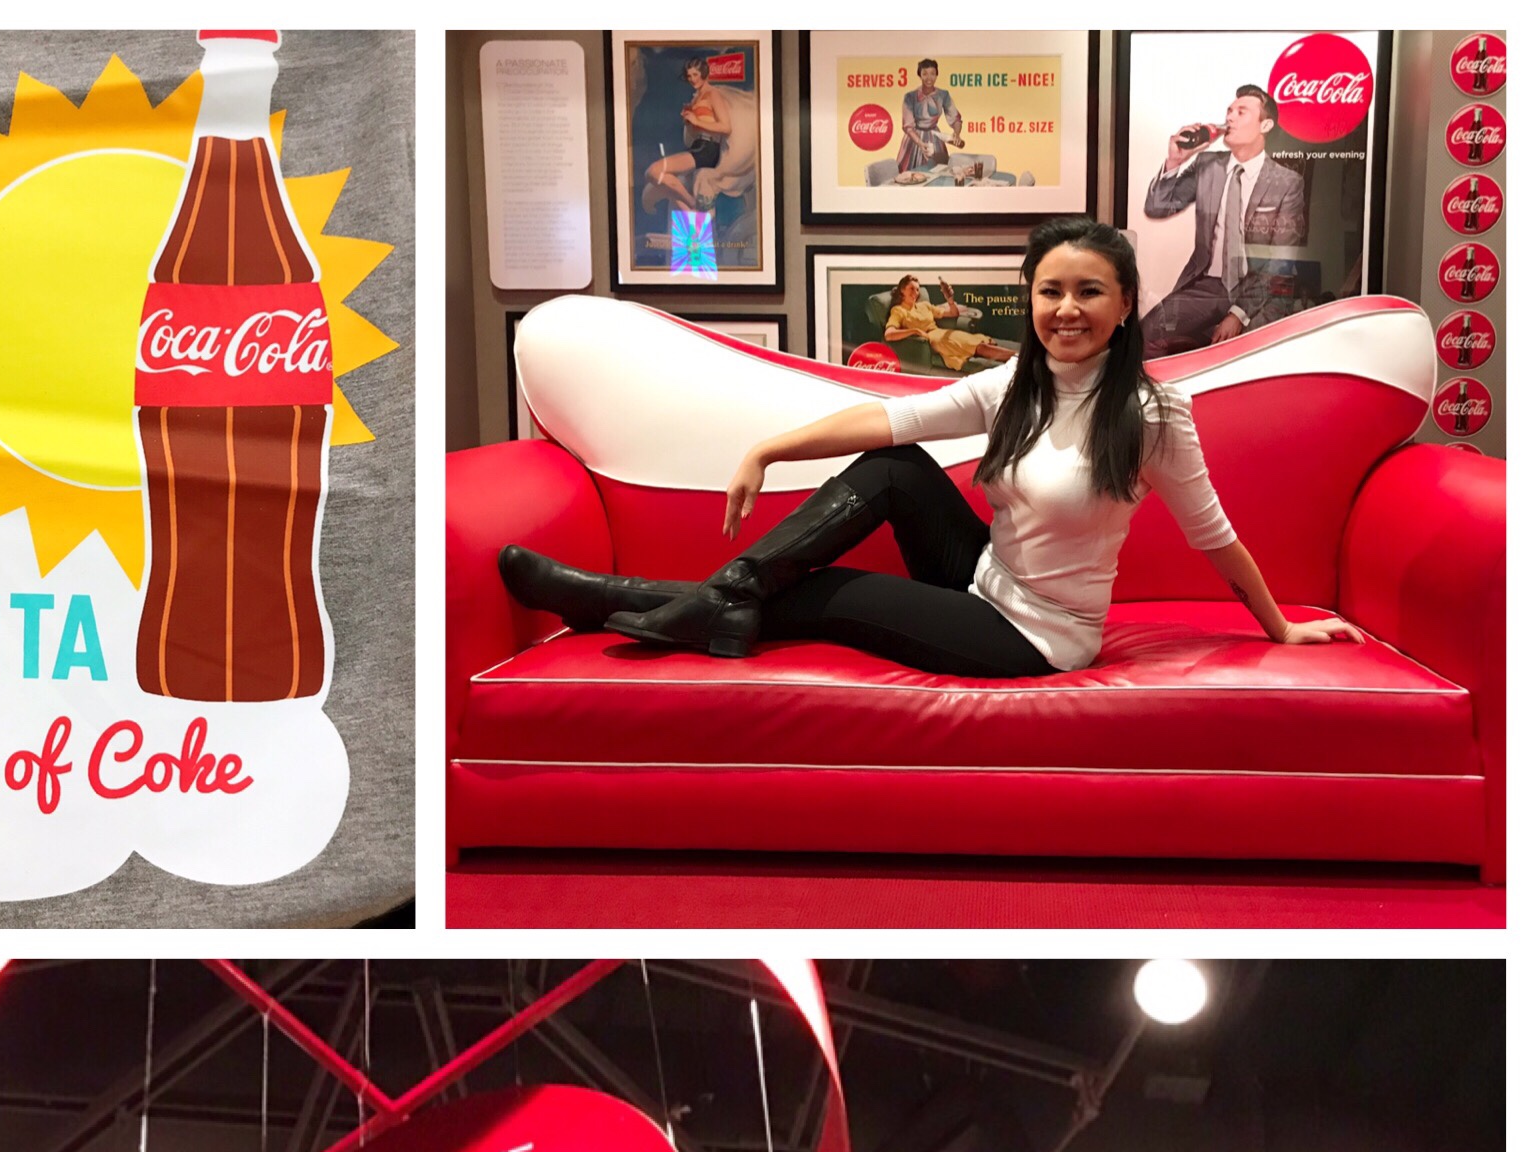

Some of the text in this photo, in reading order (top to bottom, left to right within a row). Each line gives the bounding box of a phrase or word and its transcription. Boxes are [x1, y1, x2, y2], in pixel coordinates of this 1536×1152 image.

[847, 67, 908, 88] SERVES 3
[950, 73, 983, 87] OVER
[987, 73, 1008, 87] ICE
[1273, 72, 1370, 104] Coca-Cola
[967, 122, 987, 133] BIG
[990, 116, 1005, 133] 16
[1029, 121, 1054, 133] SIZE
[1451, 126, 1503, 144] Coca-Cola
[1272, 150, 1366, 160] refresh your evening
[1447, 195, 1498, 213] Coca-Cola
[1444, 264, 1495, 282] Coca-Cola
[963, 292, 984, 303] The
[986, 295, 1019, 306] pause
[992, 305, 1026, 316] refres
[136, 307, 328, 378] Coca-Cola
[1441, 331, 1491, 349] Coca-Cola
[1437, 398, 1488, 416] Coca-Cola
[4, 715, 72, 815] of
[87, 716, 255, 796] Coke
